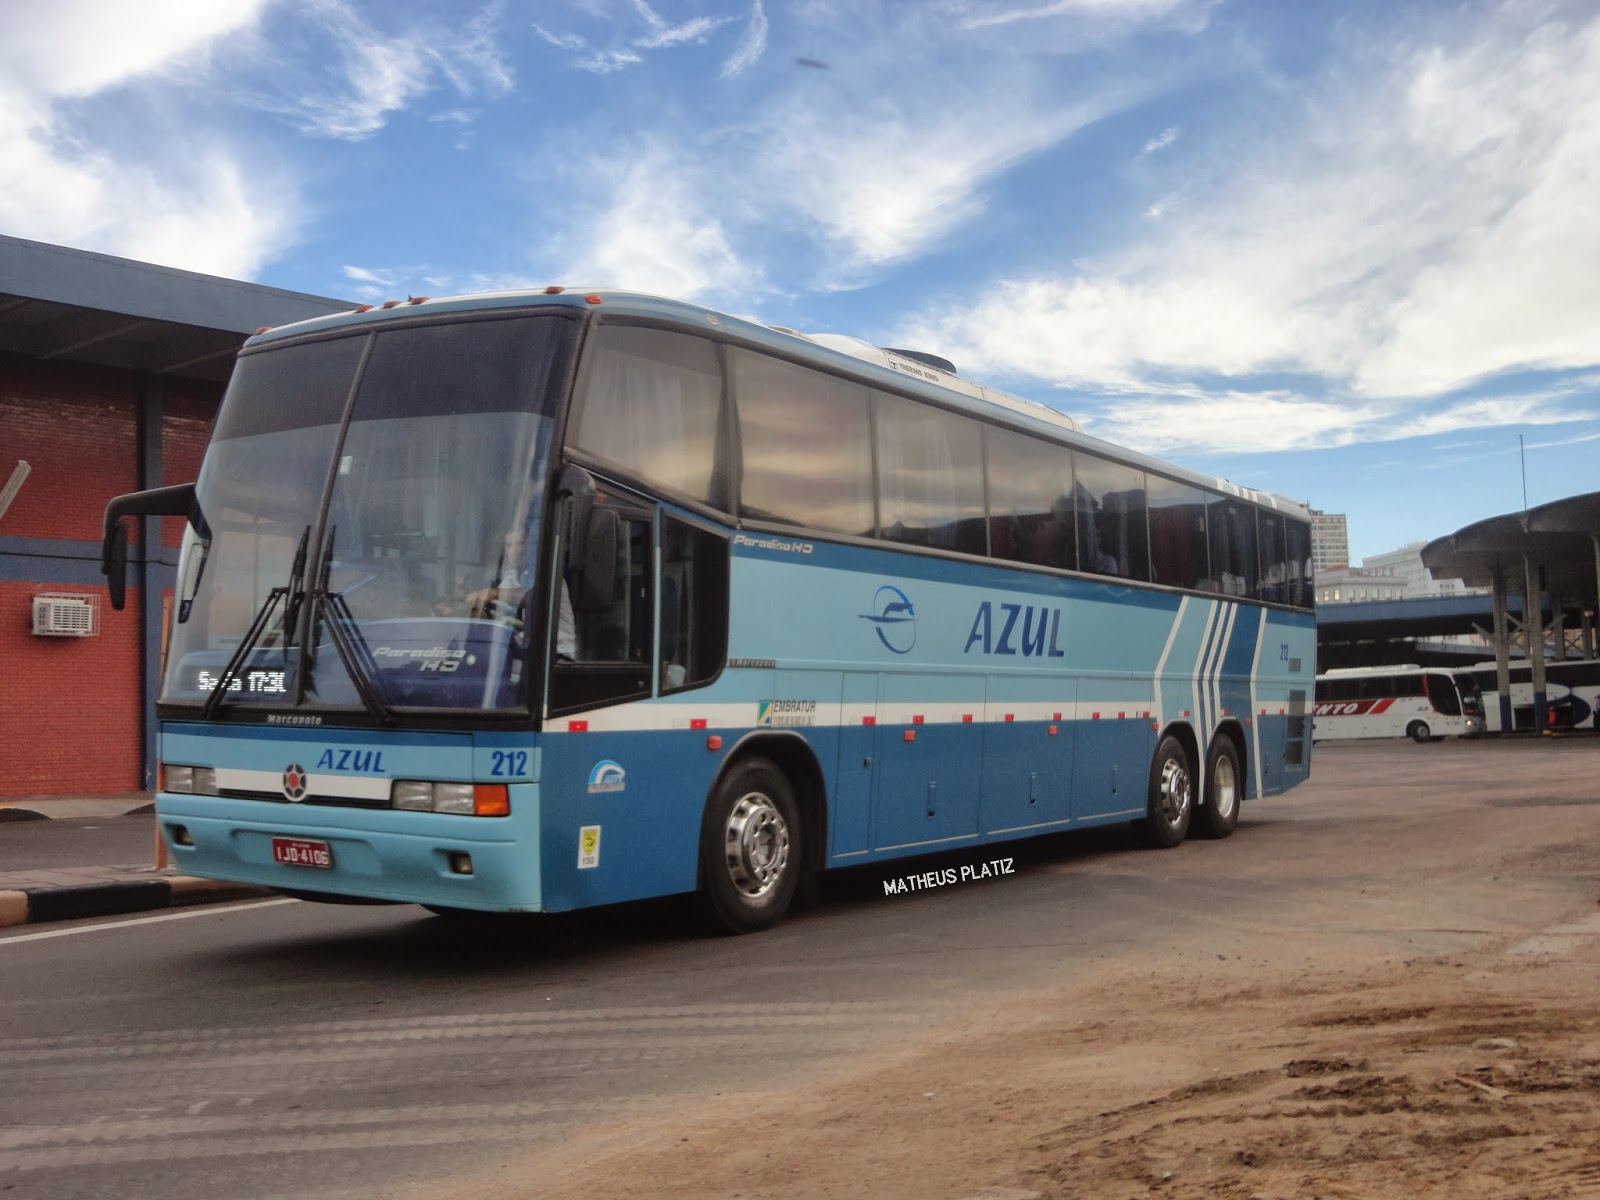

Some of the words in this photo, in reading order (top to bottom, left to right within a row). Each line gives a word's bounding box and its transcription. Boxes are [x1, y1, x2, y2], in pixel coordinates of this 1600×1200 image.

[899, 363, 922, 376] THERMO
[924, 371, 938, 381] KING
[963, 600, 1065, 658] AZUL
[773, 699, 816, 713] EMBRATUR
[267, 714, 322, 725] Marcopolo
[316, 748, 386, 773] AZUL
[491, 750, 528, 776] 212
